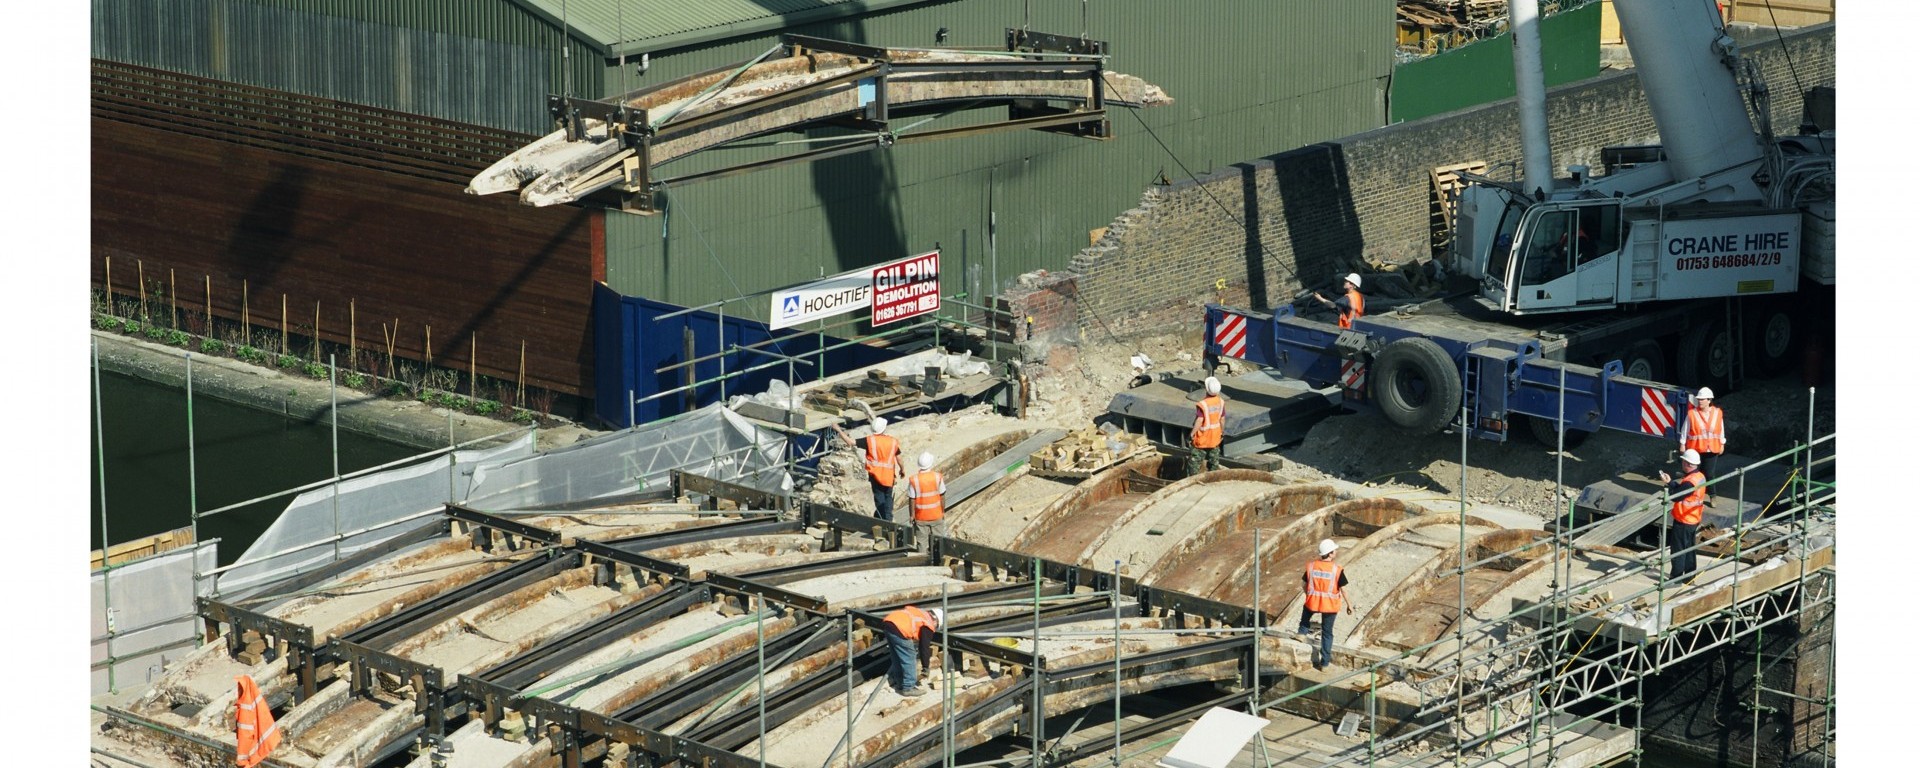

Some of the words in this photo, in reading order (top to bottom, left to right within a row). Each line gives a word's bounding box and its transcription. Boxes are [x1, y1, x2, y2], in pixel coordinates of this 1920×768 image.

[1668, 234, 1738, 256] CRANE
[1744, 232, 1789, 251] HIRE
[876, 256, 936, 292] GILPIN
[1676, 257, 1710, 271] 01753
[1712, 252, 1781, 269] 648684/2/9
[804, 285, 871, 314] HOCHTIEF
[876, 280, 937, 306] DEMOLITION
